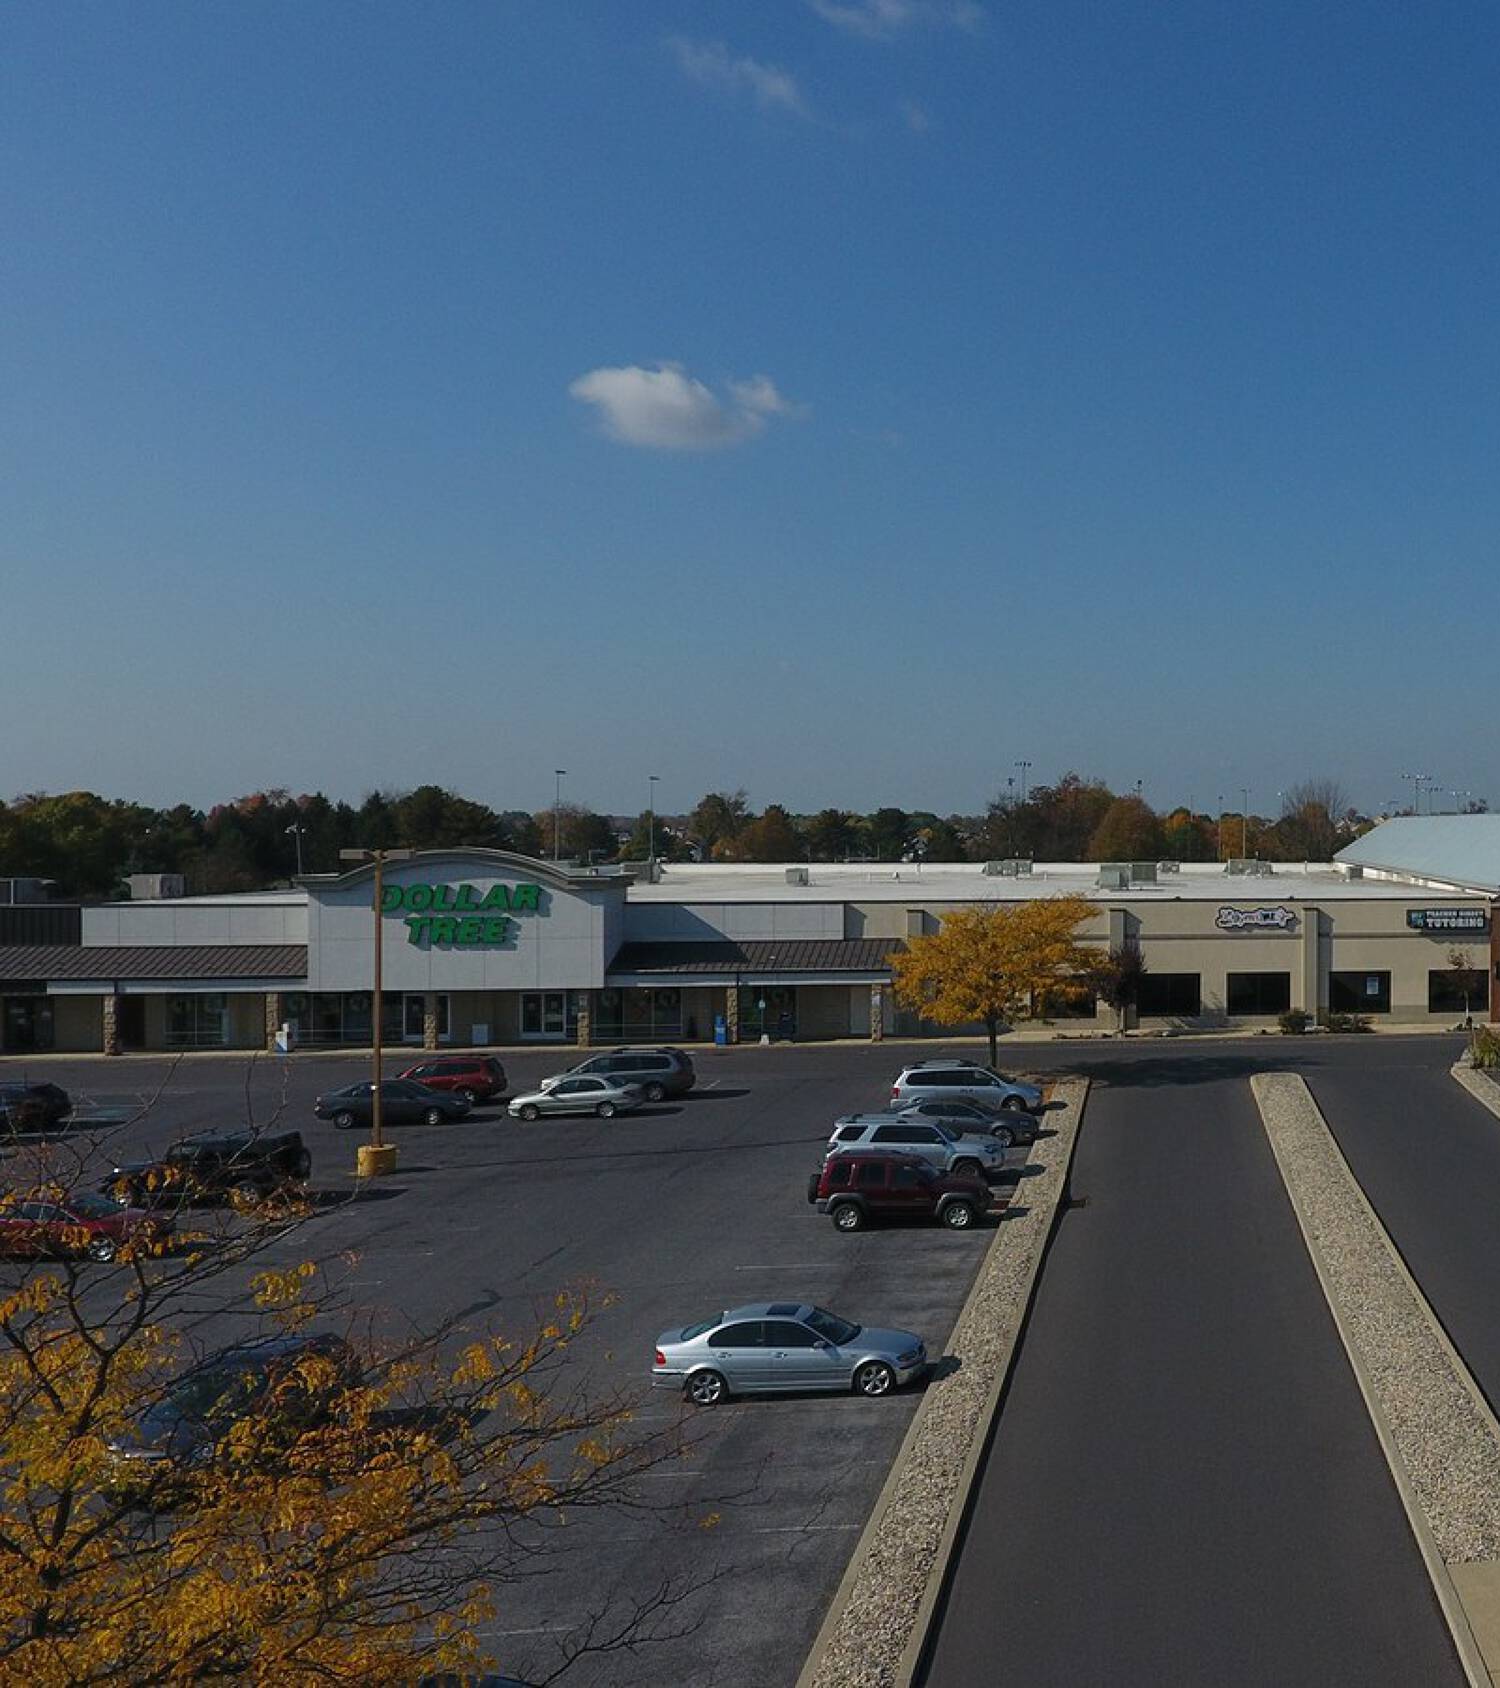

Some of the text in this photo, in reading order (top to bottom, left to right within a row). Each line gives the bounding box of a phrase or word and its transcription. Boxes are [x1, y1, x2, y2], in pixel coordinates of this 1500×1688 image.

[373, 884, 541, 911] DOLLAR
[404, 916, 513, 945] TREE
[1426, 918, 1484, 928] TUTORING
